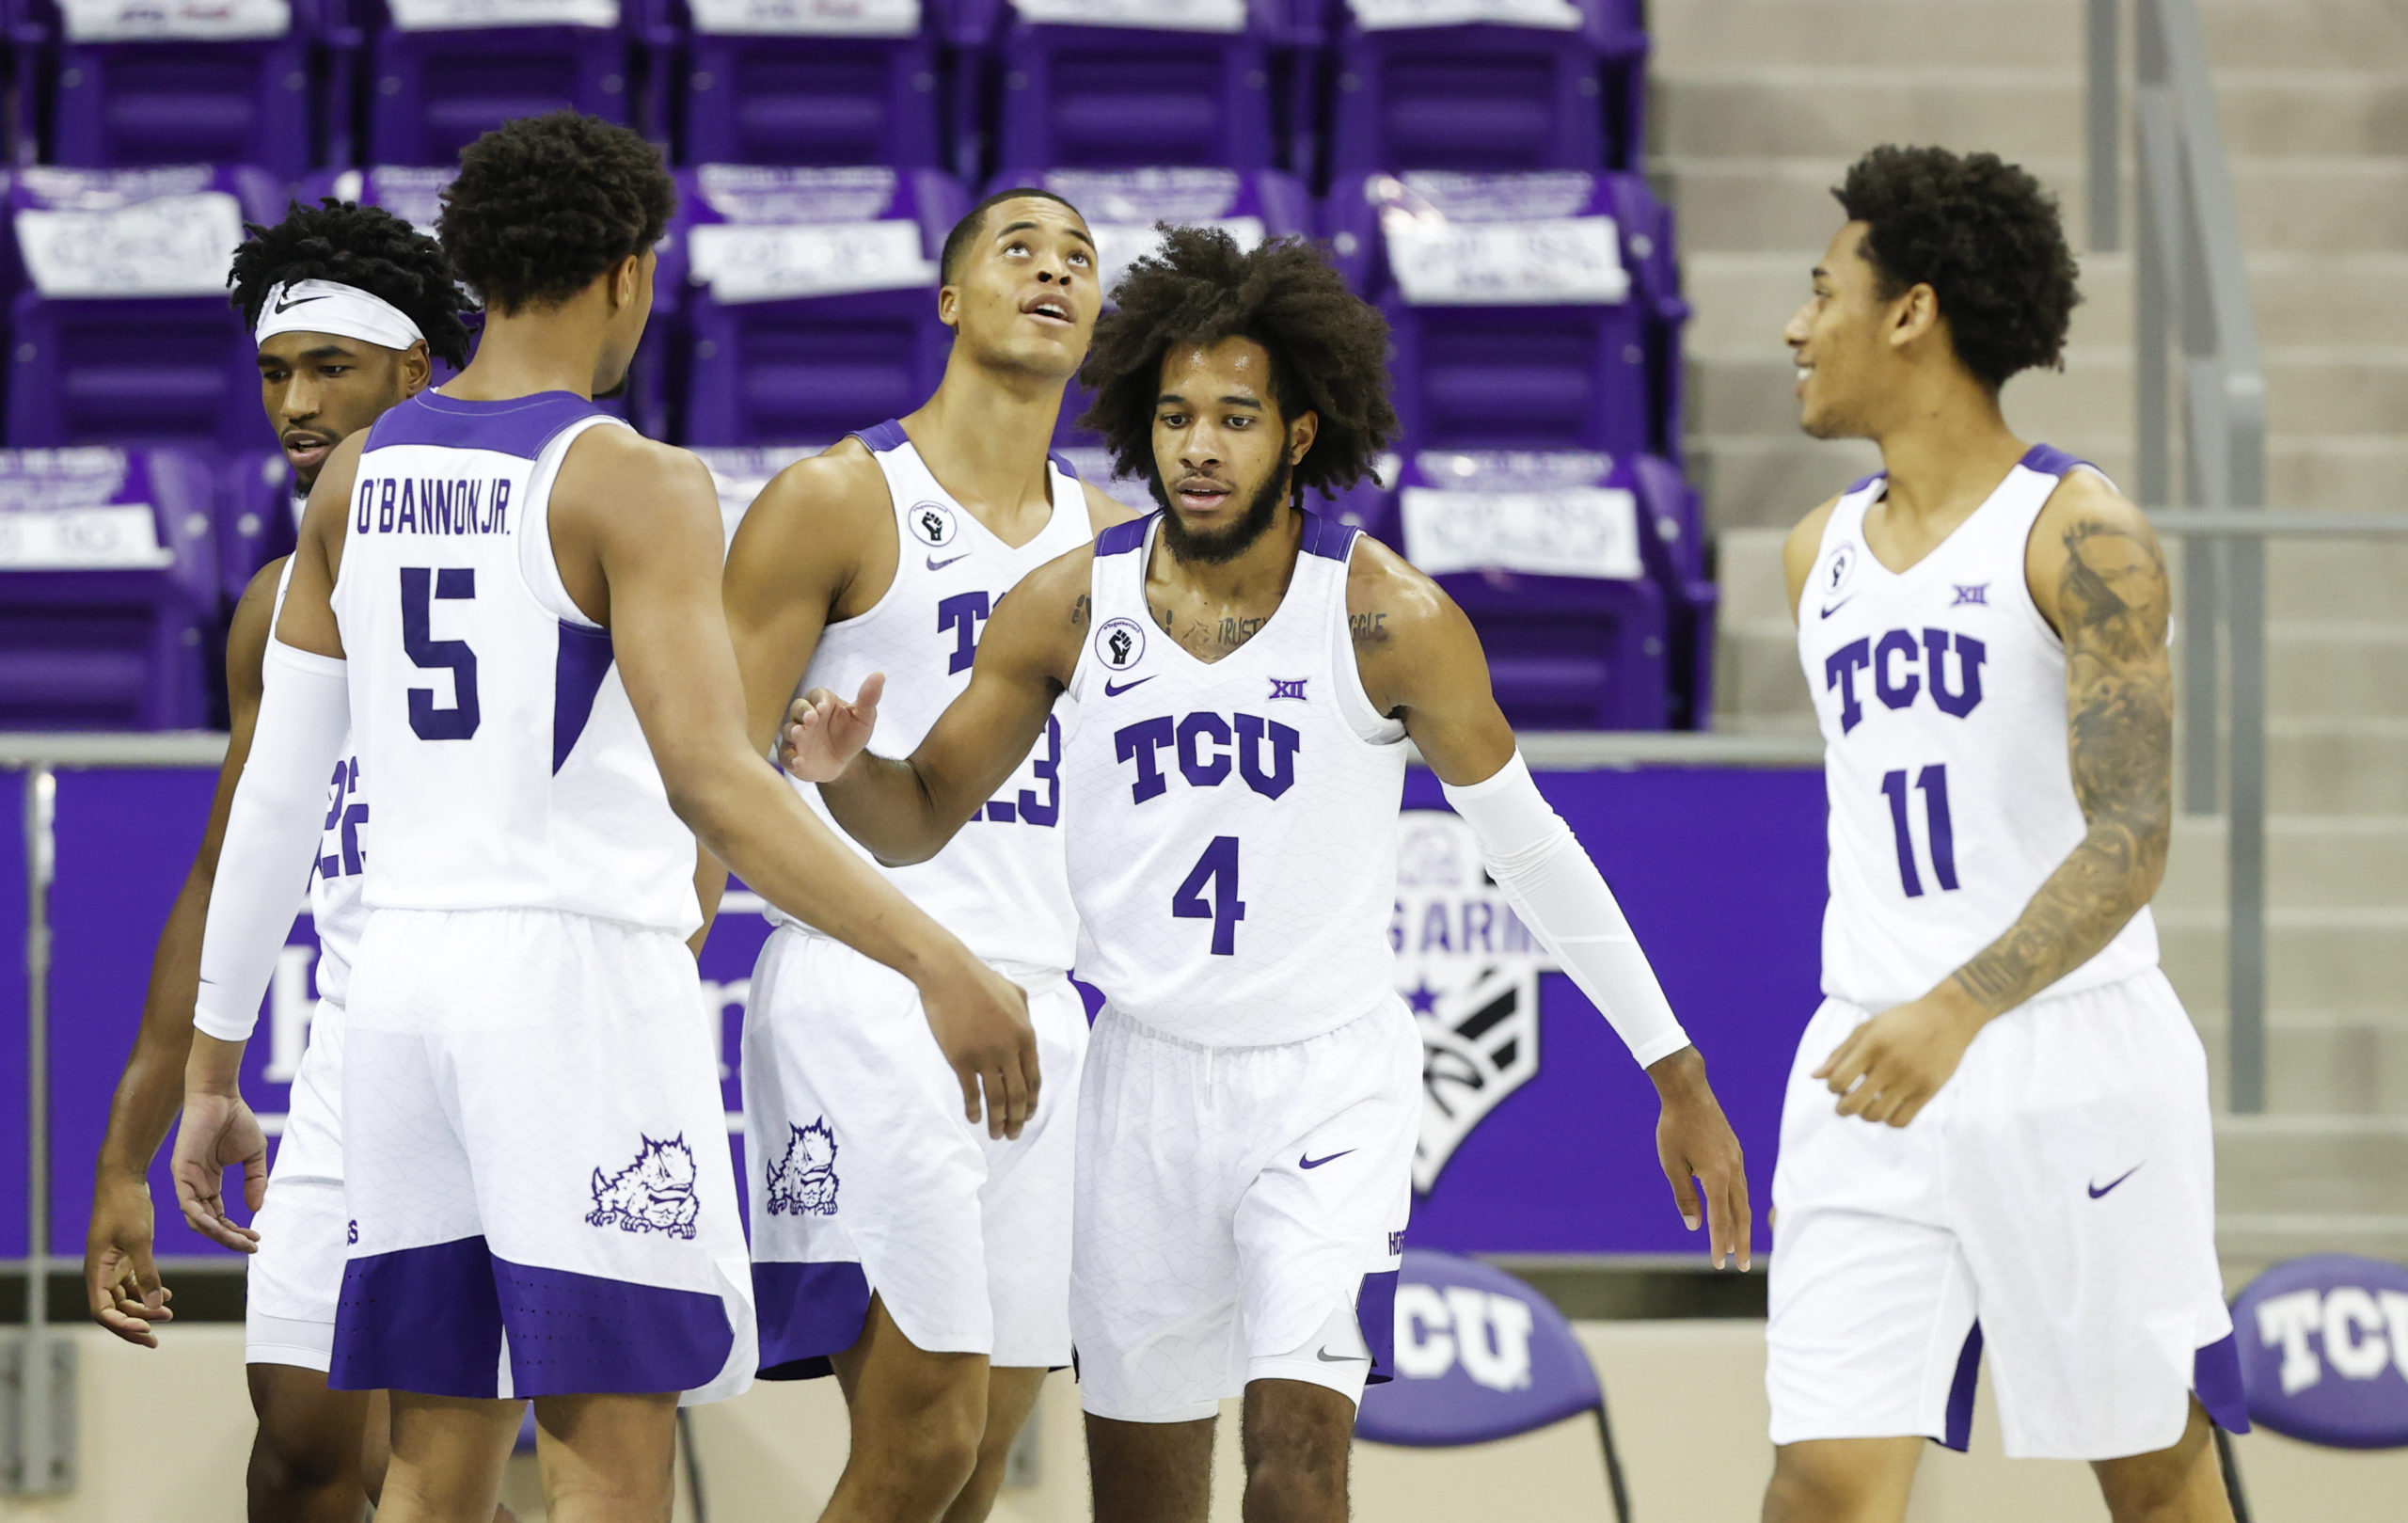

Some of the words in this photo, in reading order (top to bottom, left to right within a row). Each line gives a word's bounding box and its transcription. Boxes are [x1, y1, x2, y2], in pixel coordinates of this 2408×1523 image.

[356, 478, 482, 535] O'BANNON
[482, 478, 511, 535] JR.
[400, 566, 481, 740] 5
[1268, 678, 1308, 701] XII
[1825, 627, 1988, 736] TCU
[969, 712, 1061, 828] 3
[1114, 711, 1300, 805] TCU
[1879, 763, 1960, 898] 11
[1172, 835, 1246, 956] 4
[1393, 1283, 1533, 1393] CU
